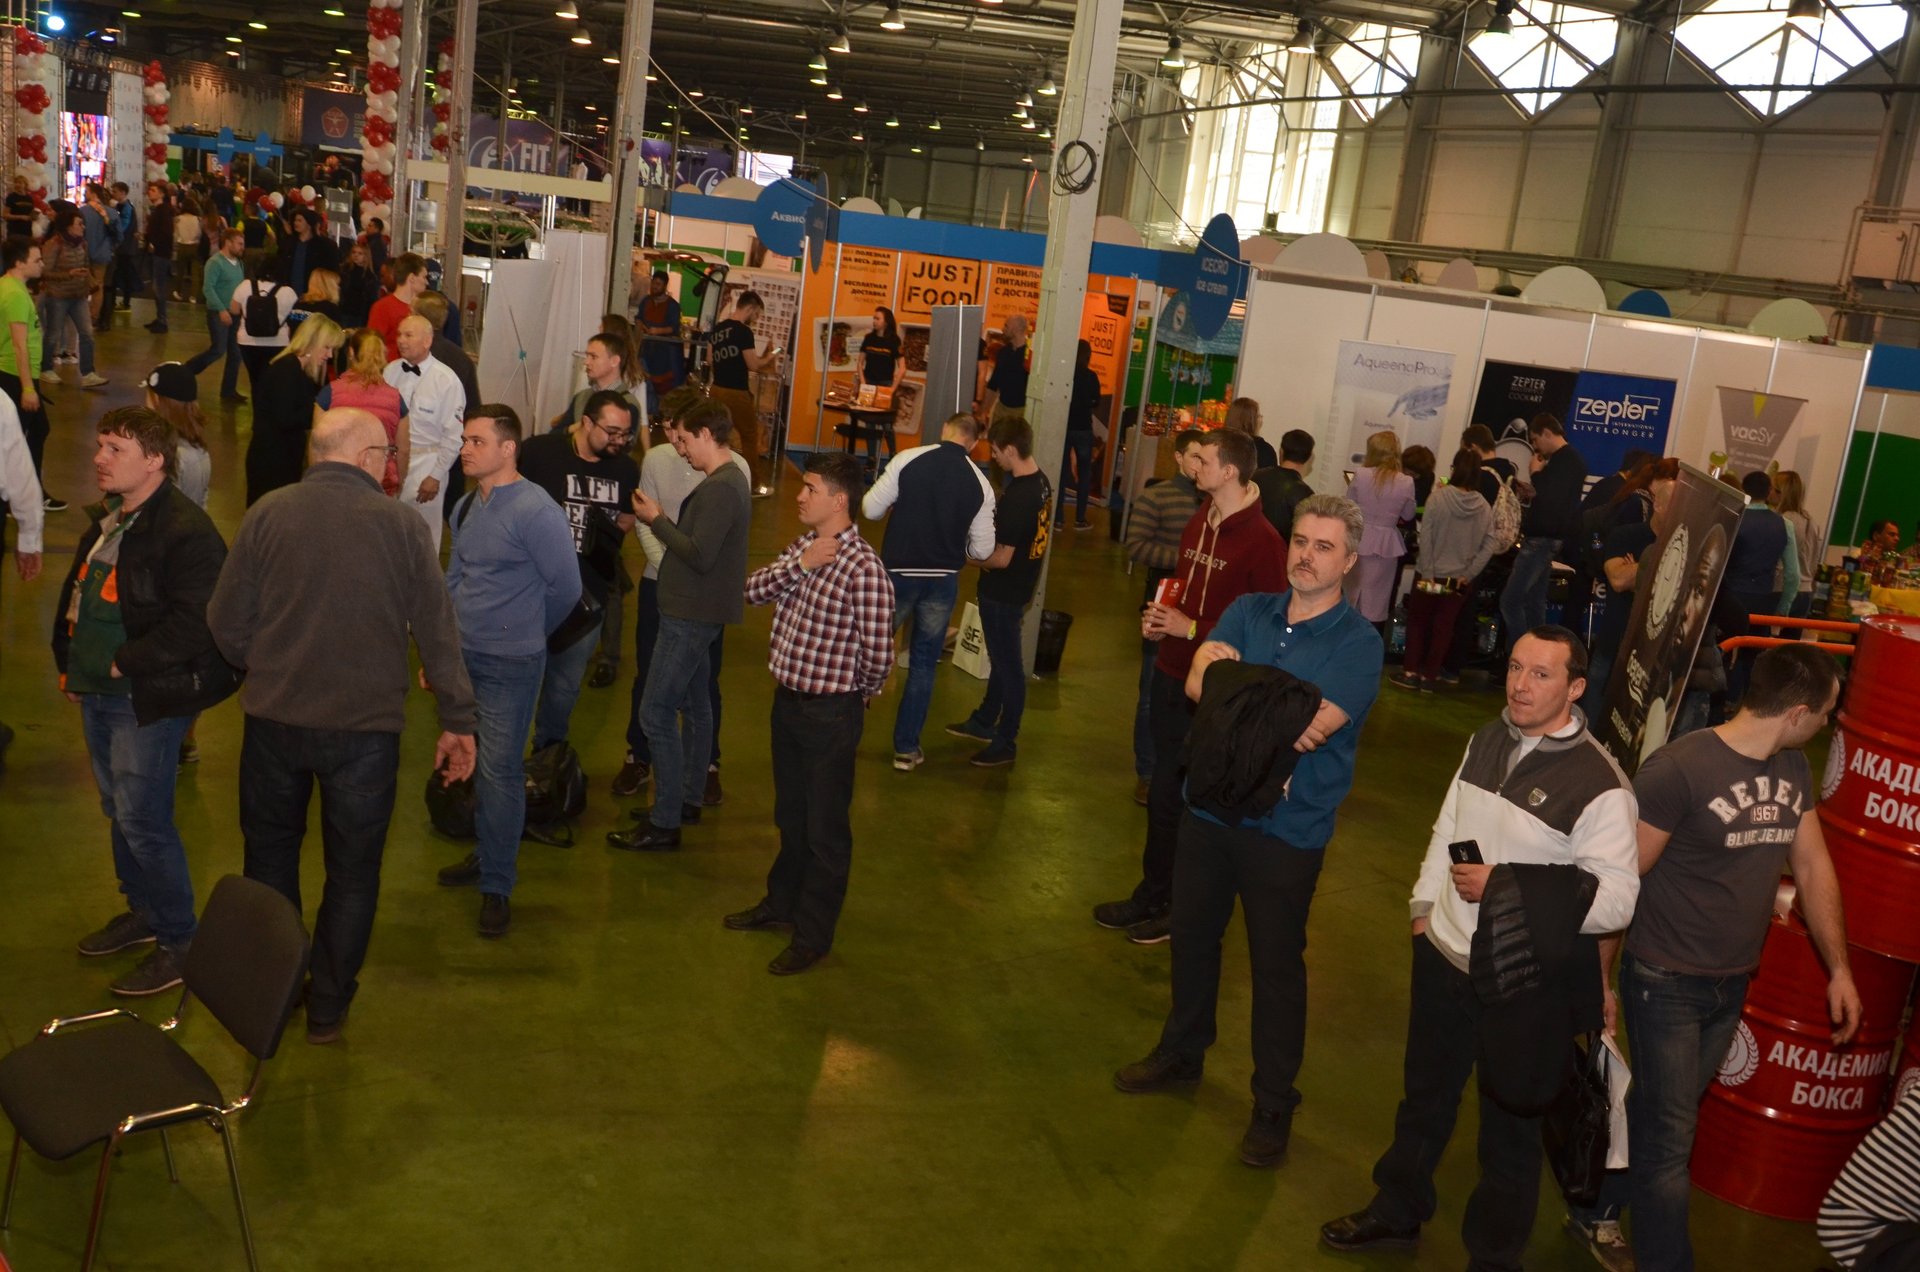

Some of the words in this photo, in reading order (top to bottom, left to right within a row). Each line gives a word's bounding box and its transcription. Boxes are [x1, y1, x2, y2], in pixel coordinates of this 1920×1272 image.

[520, 142, 550, 173] FIT
[855, 250, 891, 259] ПОЛЕЗНАЯ
[912, 261, 974, 285] JUST
[844, 280, 887, 289] БЕСПЛАТНАЯ
[994, 287, 1001, 295] С
[995, 277, 1040, 289] ПИТАНИЕ
[851, 288, 886, 297] ДОСТАВКА
[1092, 320, 1114, 334] JUST
[711, 327, 732, 345] UST
[1089, 335, 1112, 350] FOOD
[714, 345, 739, 362] OOD
[1511, 375, 1546, 390] ZEPTER
[1577, 394, 1660, 426] zepter
[571, 475, 617, 502] LFT
[1183, 548, 1228, 570] SYEGY
[1753, 805, 1778, 822] 1967
[1725, 829, 1758, 848] BLUE
[1757, 827, 1795, 844] JEANS
[1767, 1040, 1891, 1081] АКАДЕМИЯ
[1791, 1080, 1864, 1111] БОКСА
